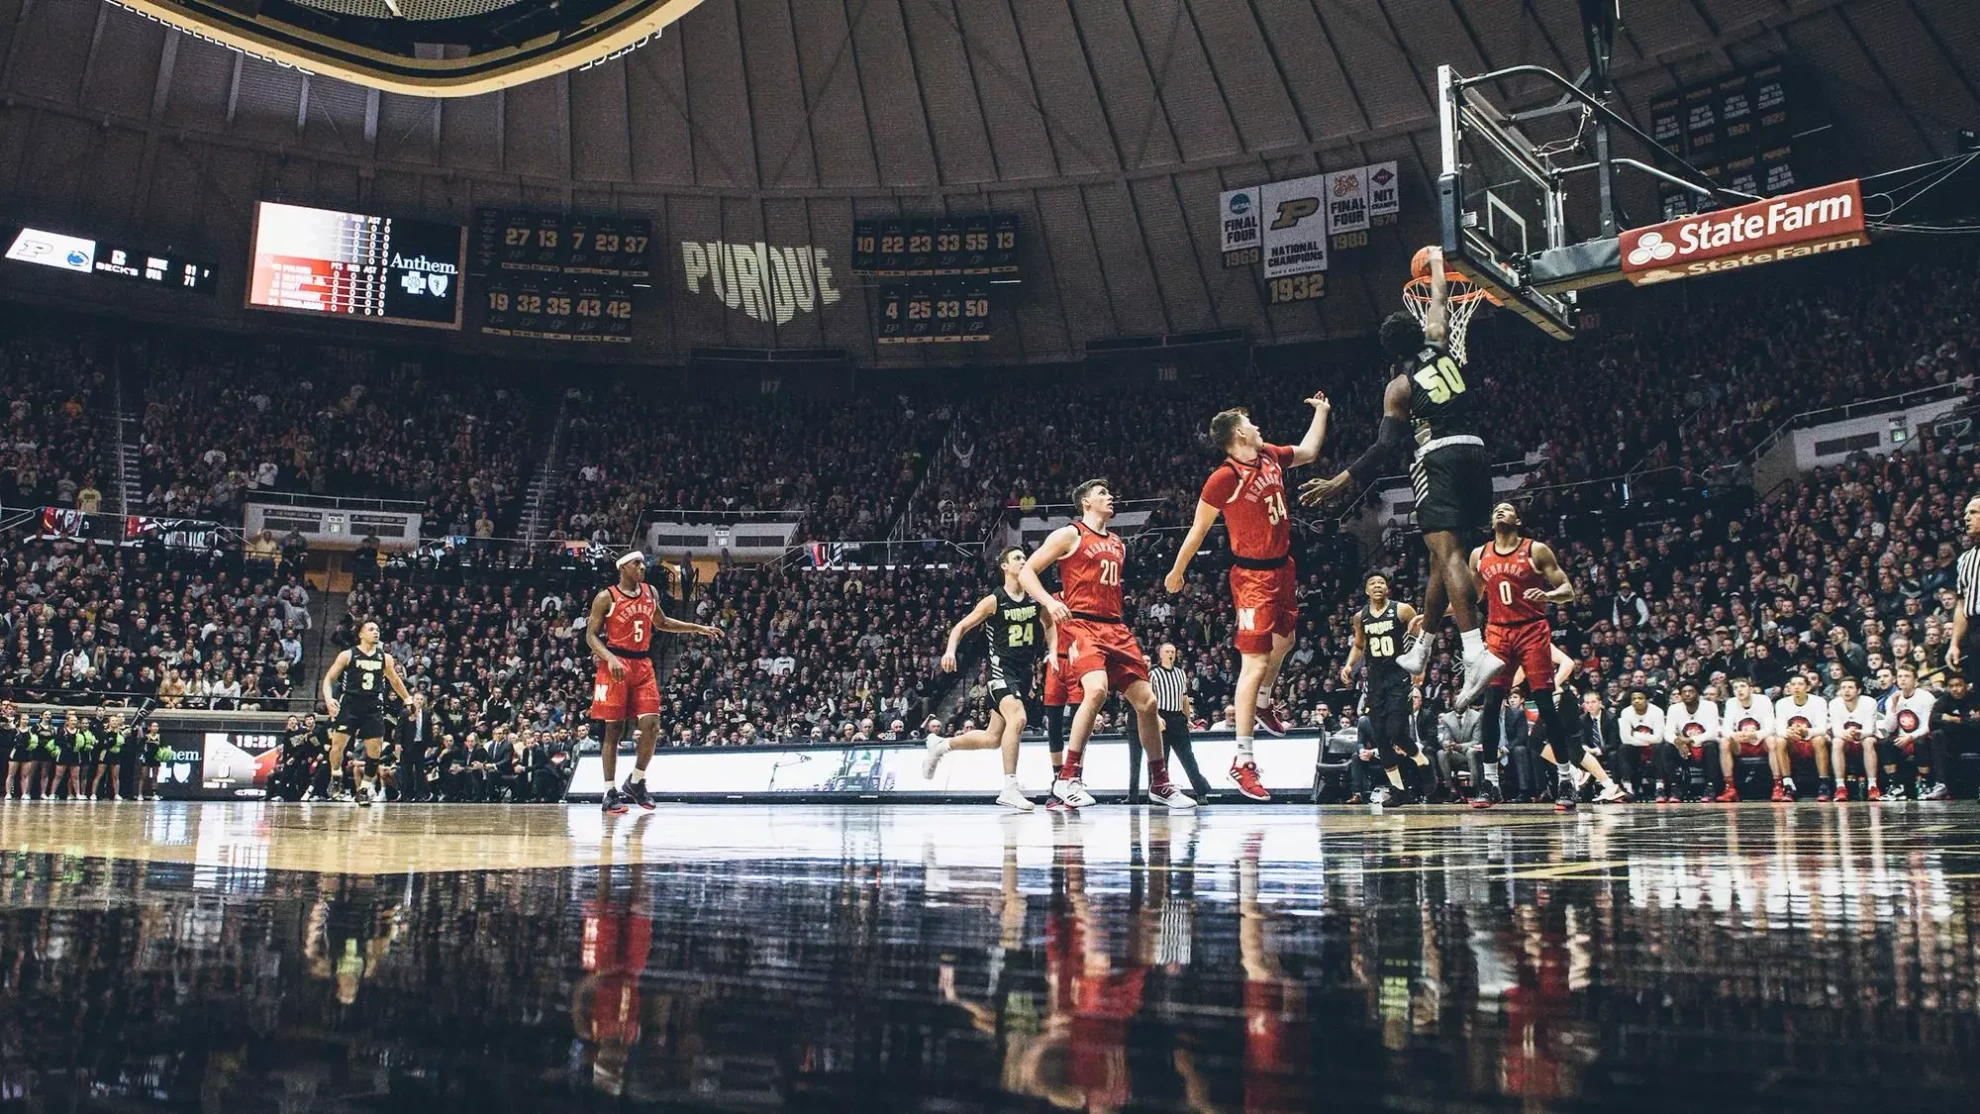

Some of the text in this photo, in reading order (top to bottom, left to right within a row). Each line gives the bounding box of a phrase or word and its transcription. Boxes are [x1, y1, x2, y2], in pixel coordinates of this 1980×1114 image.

[1374, 189, 1394, 202] NIT
[1331, 197, 1366, 214] FINAL
[368, 217, 381, 225] AST
[1225, 216, 1257, 232] FINAL
[1334, 211, 1364, 227] FOUR
[505, 228, 530, 246] 27
[538, 229, 558, 247] 13
[573, 232, 584, 249] 7
[595, 234, 619, 252] 23
[625, 236, 648, 253] 37
[857, 237, 875, 253] 10
[882, 237, 904, 253] 22
[909, 235, 932, 253] 23
[937, 234, 960, 252] 33
[966, 233, 988, 250] 55
[996, 232, 1014, 249] 13
[1227, 228, 1256, 244] FOUR
[1225, 248, 1259, 267] 1969
[1271, 241, 1318, 257] NATIONAL
[1268, 251, 1323, 267] CHAMPIONS
[363, 266, 377, 274] AST
[681, 240, 841, 325] PURDUE
[1270, 273, 1324, 303] 1932
[489, 292, 509, 311] 19
[517, 295, 541, 313] 32
[547, 297, 571, 316] 35
[577, 299, 600, 317] 43
[606, 300, 631, 319] 42
[886, 302, 898, 319] 4
[909, 301, 931, 319] 25
[937, 300, 960, 318] 33
[965, 299, 988, 317] 50
[1413, 355, 1466, 404] 50
[1264, 491, 1288, 526] 34
[1100, 559, 1118, 587] 20
[1499, 580, 1513, 606] 0
[1004, 605, 1037, 621] PURDUE
[1238, 607, 1256, 631] N
[633, 620, 644, 643] 5
[1008, 623, 1034, 647] 24
[1364, 620, 1394, 635] PURDUE
[1370, 635, 1394, 657] 20
[362, 672, 375, 690] 3
[594, 683, 609, 702] N
